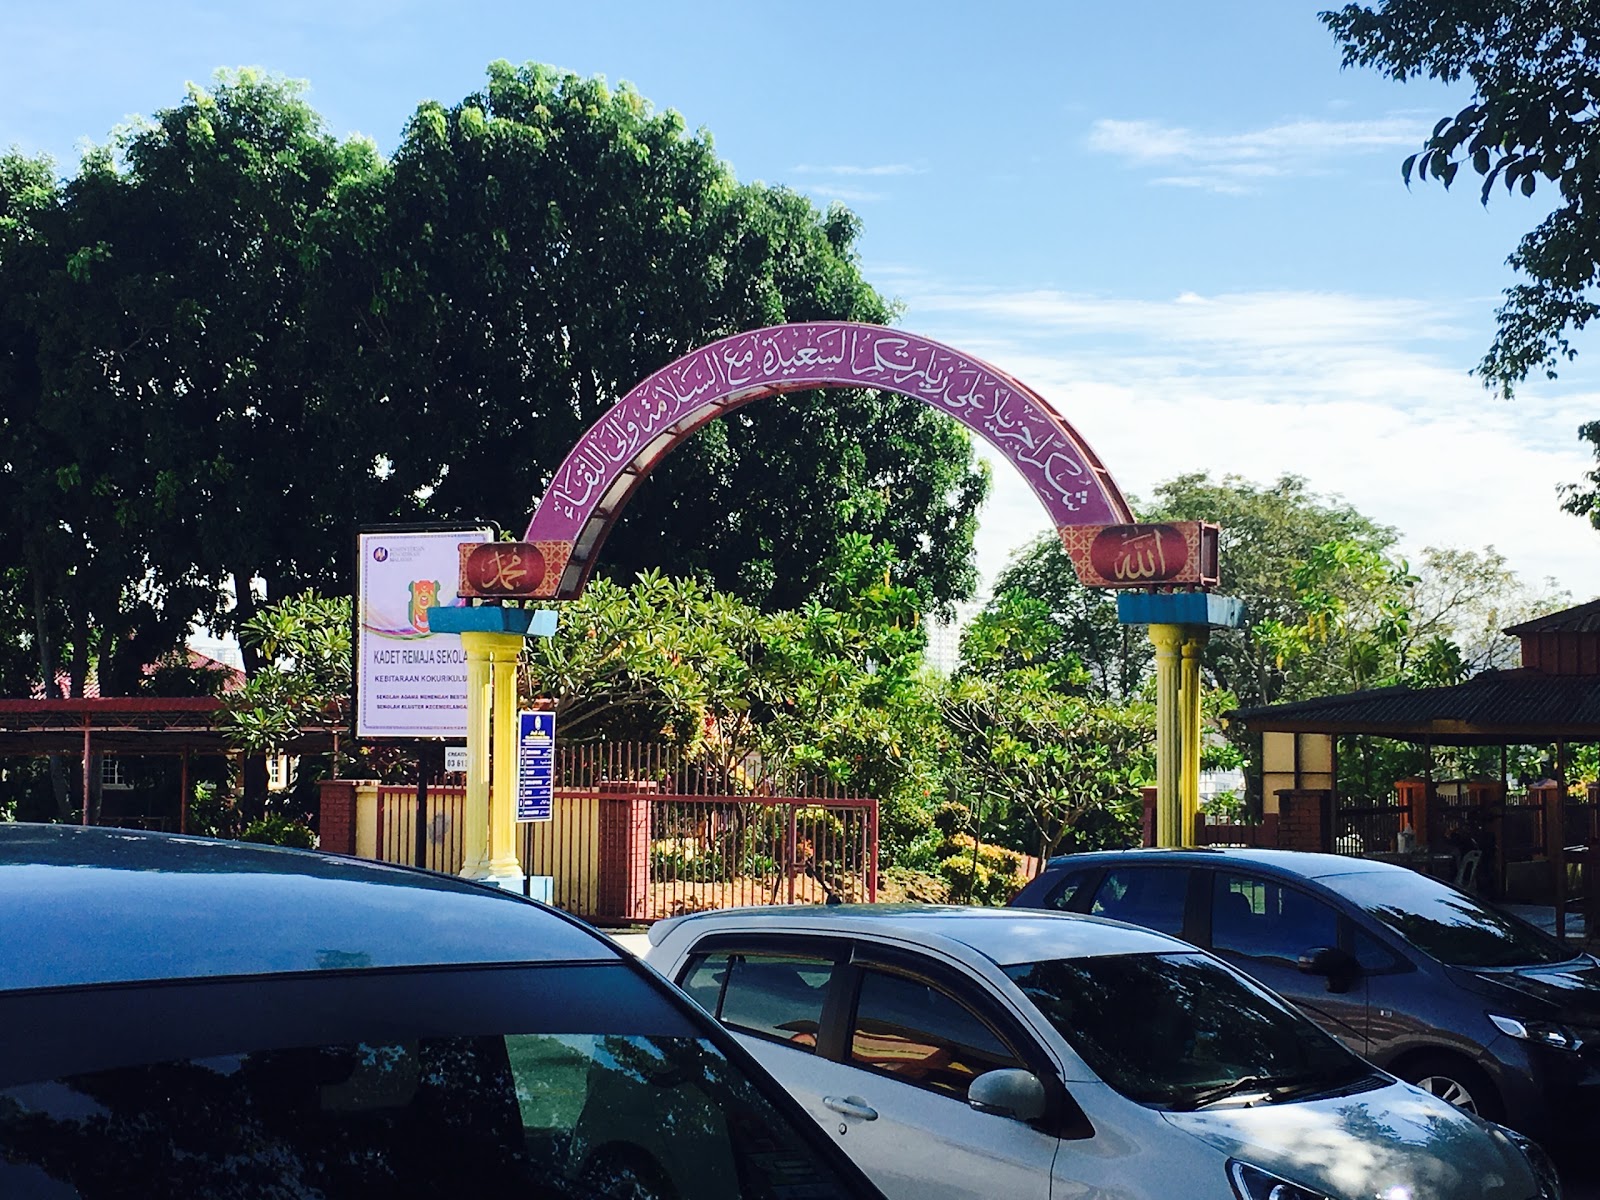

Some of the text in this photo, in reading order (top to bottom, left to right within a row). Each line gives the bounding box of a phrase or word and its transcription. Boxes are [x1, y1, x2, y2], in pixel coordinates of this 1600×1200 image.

[1114, 529, 1166, 580] الله
[373, 649, 468, 664] KADET REMAJA SEKOLA
[374, 675, 468, 683] KEBITARAAN KOKURIKULU
